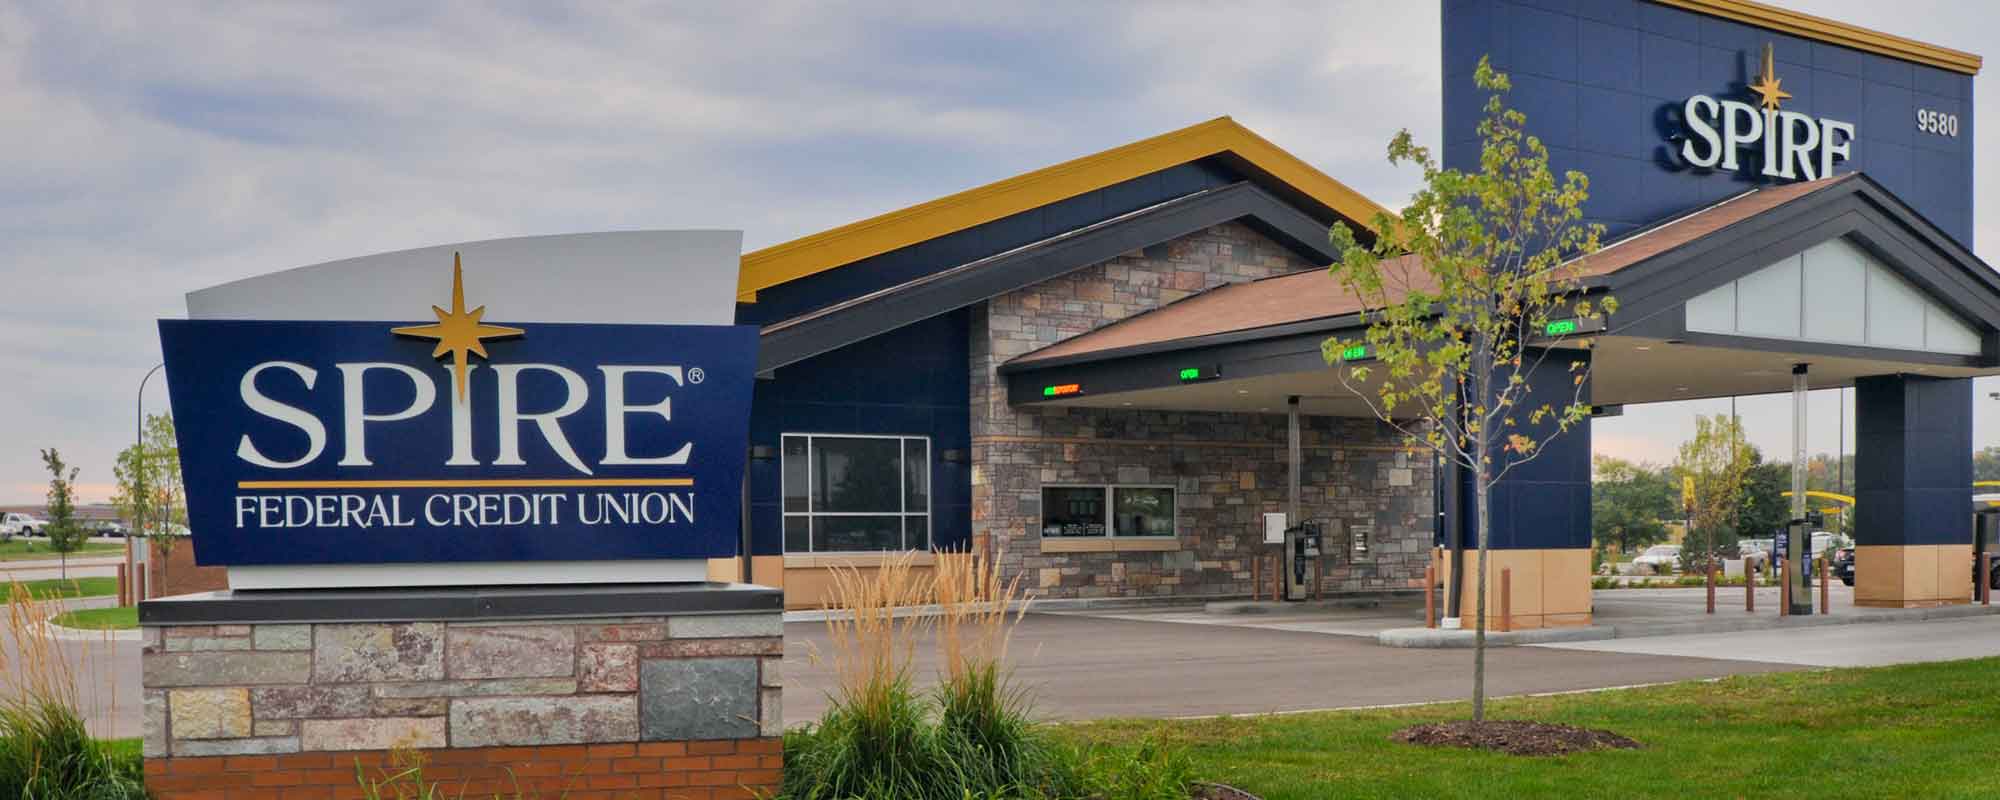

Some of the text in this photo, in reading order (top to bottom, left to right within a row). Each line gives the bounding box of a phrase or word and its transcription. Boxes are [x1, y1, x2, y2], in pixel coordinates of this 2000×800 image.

[1682, 94, 1855, 182] SPIRE
[1917, 109, 1958, 137] 9580
[235, 492, 695, 528] FEDERAL CREDIT UNION
